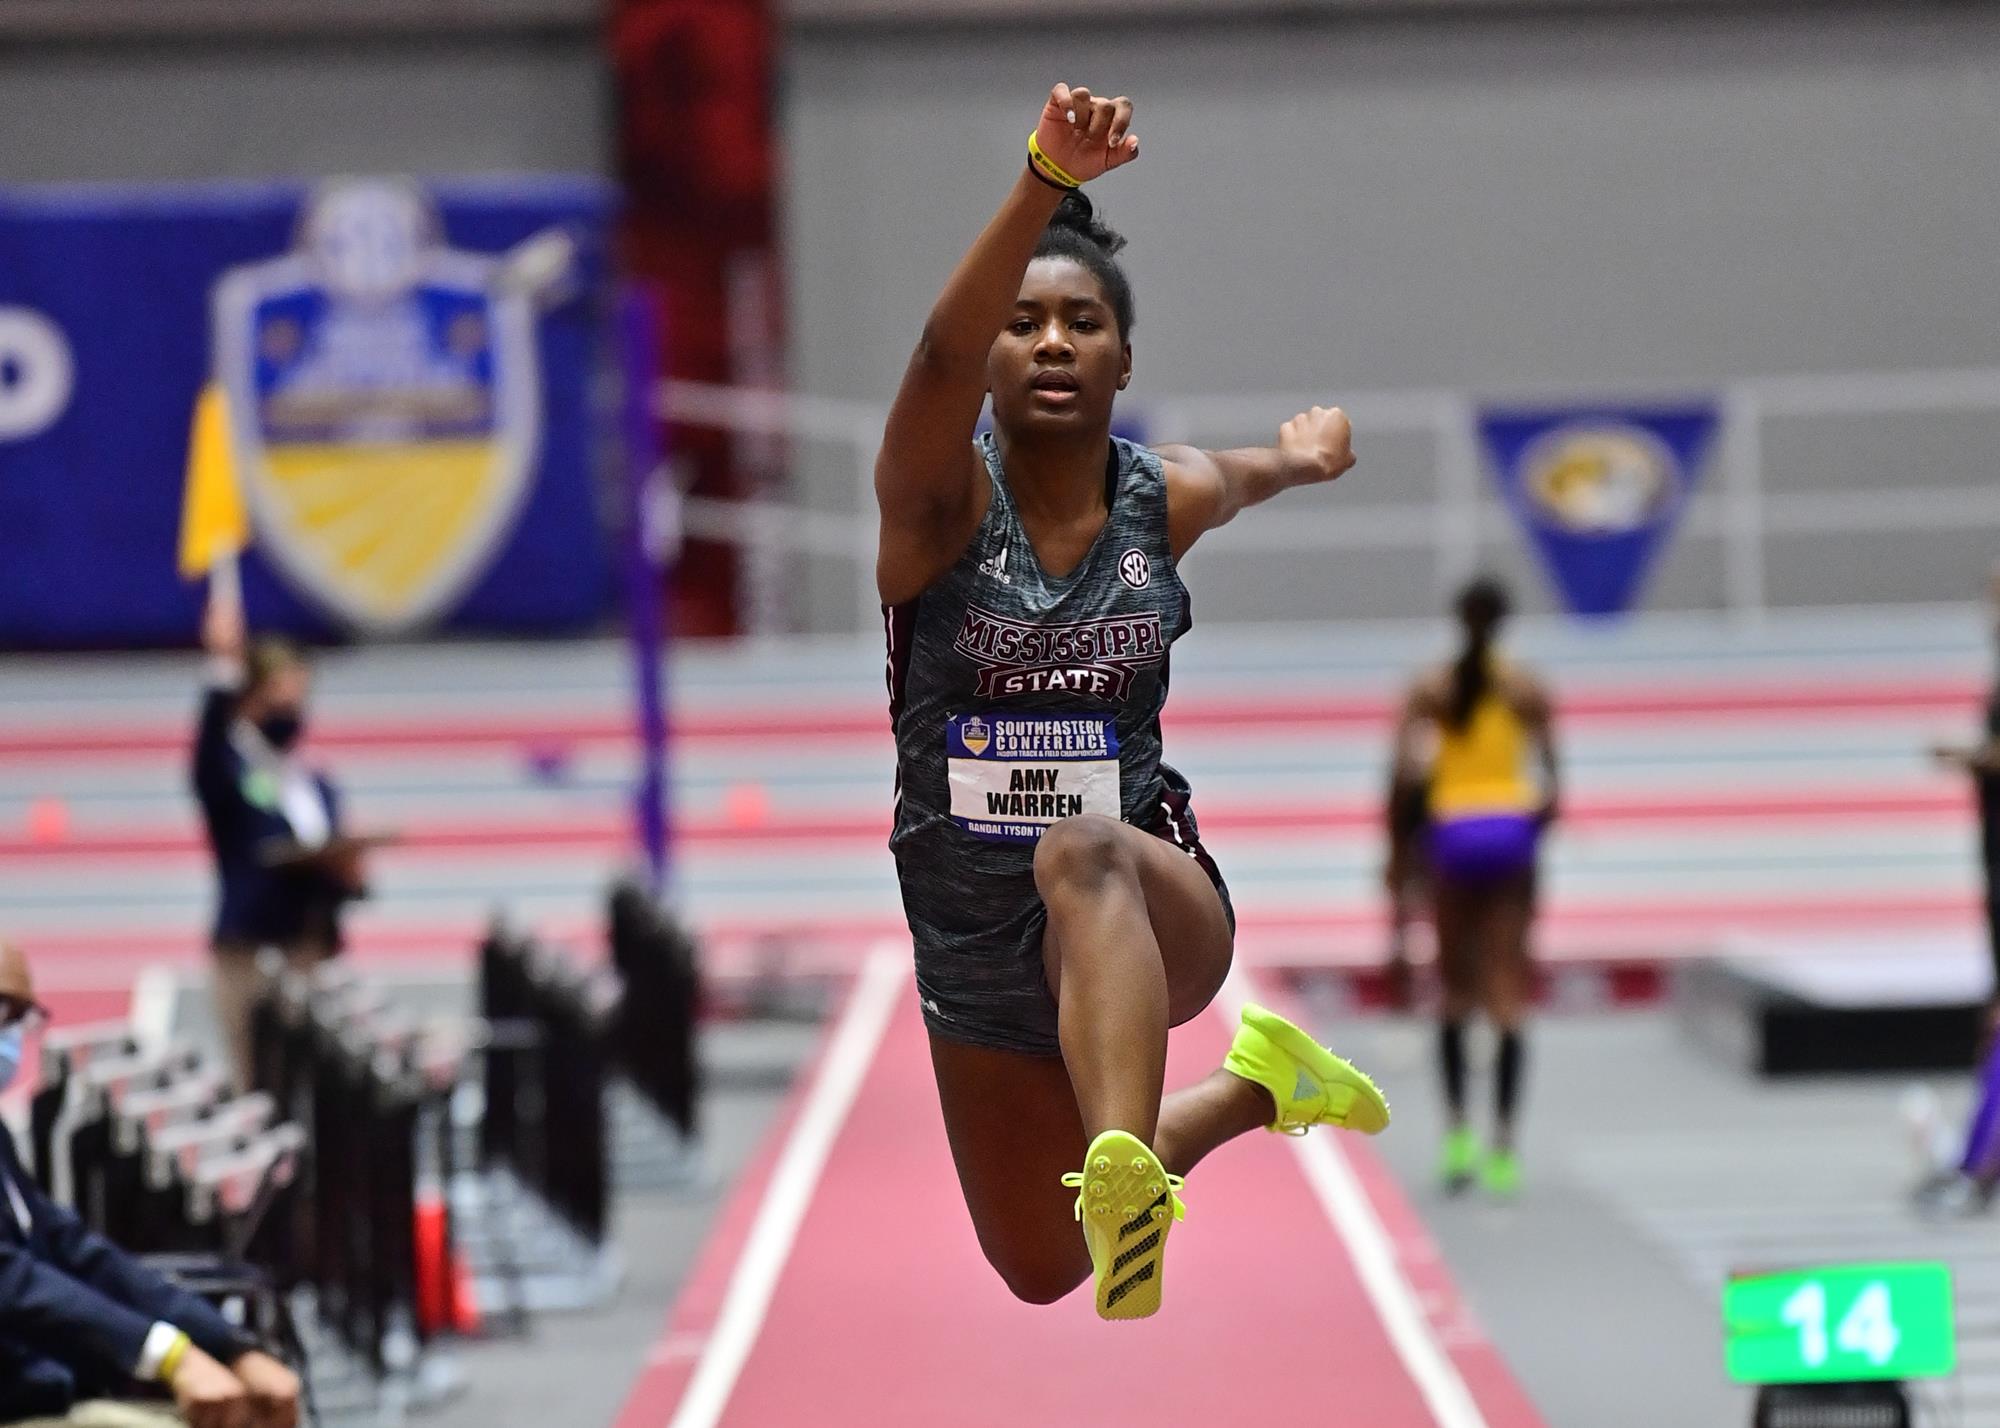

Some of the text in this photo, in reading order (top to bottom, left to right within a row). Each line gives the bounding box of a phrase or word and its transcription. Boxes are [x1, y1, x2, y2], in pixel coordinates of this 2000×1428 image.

[1122, 552, 1149, 586] SEC
[957, 612, 1164, 663] MISSISSIPPI
[1005, 669, 1110, 693] STATE
[995, 720, 1104, 736] SOUTHEASTERN
[995, 735, 1108, 750] CONFERENCE
[1009, 769, 1059, 792] AMY
[986, 792, 1083, 818] WARREN
[968, 822, 1002, 835] RANDAL
[1003, 825, 1033, 837] TYSON
[1780, 1280, 1901, 1368] 14
